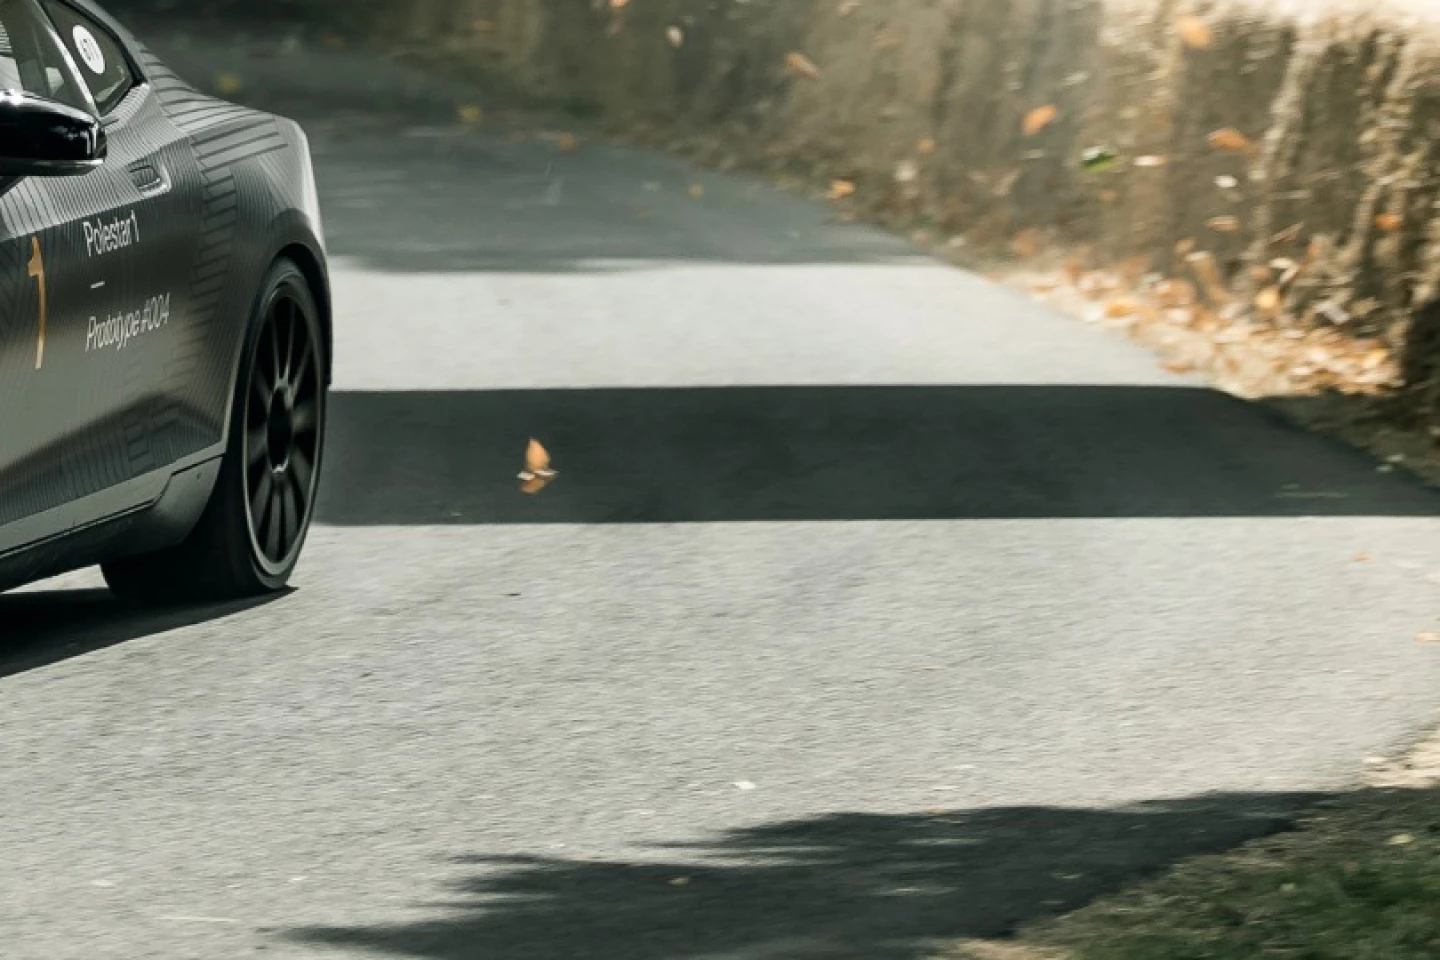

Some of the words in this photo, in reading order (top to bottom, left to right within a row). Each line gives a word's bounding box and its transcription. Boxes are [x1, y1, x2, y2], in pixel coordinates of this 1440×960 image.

[82, 217, 132, 258] Polestar
[130, 209, 140, 243] 1
[27, 235, 46, 370] 1
[84, 310, 140, 353] Prototype
